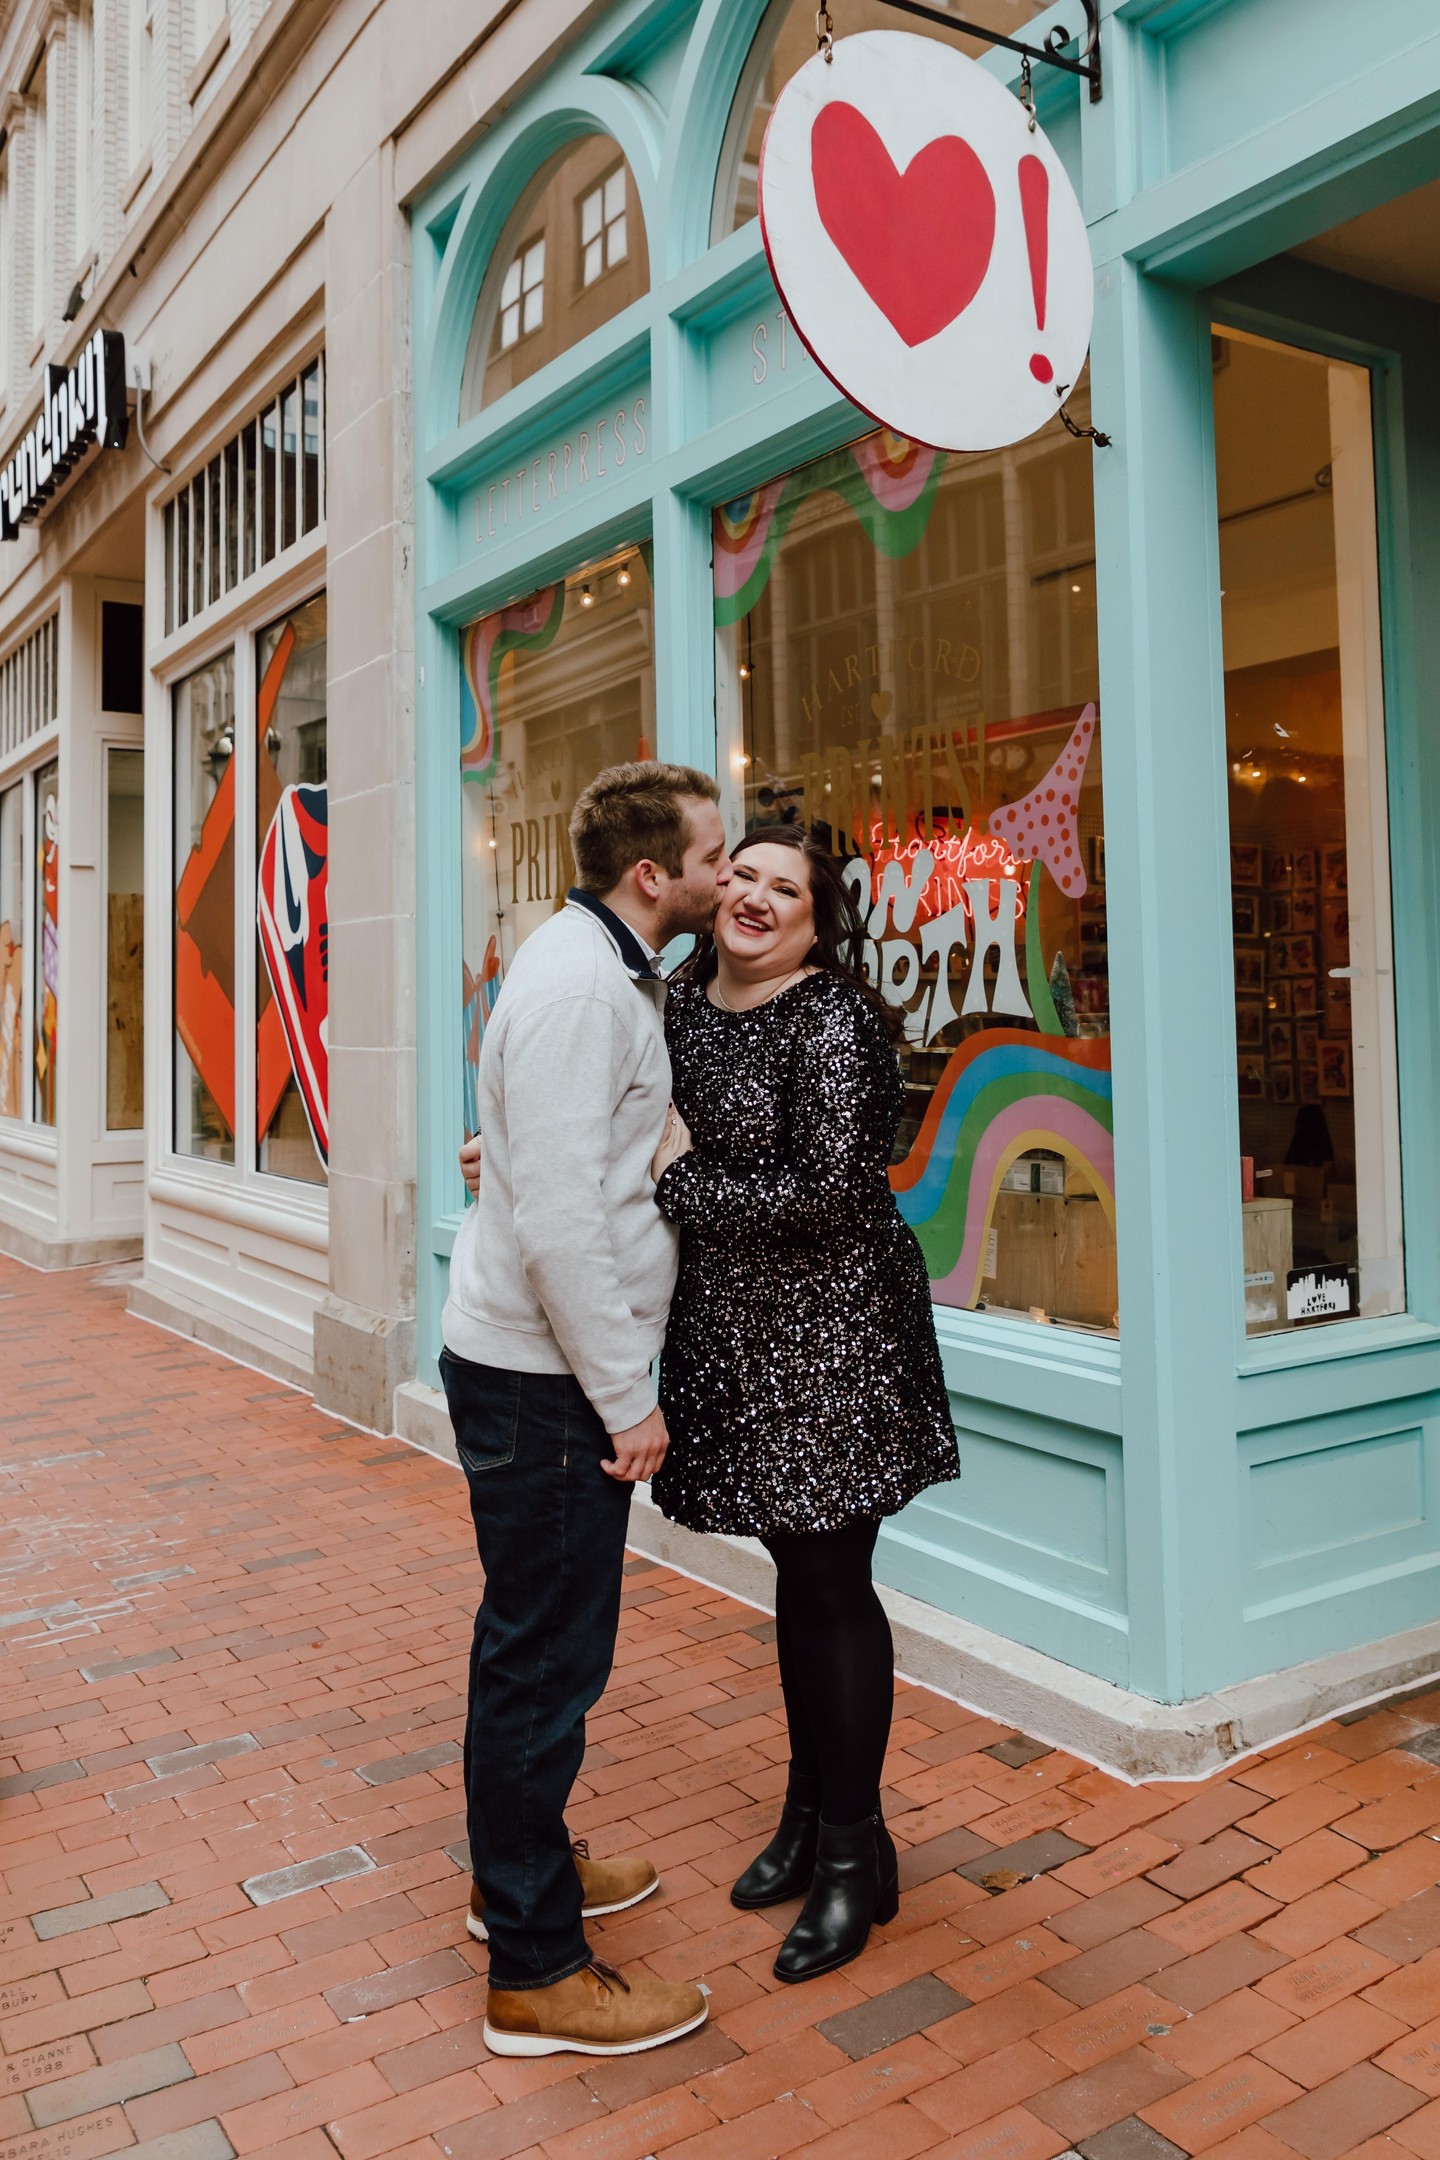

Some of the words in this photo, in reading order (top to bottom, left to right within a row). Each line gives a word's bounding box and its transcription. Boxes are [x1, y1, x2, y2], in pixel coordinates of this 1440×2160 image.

[752, 309, 808, 385] ST
[474, 398, 647, 544] LETTERPRESS
[801, 635, 982, 722] HARTFORD
[1301, 1301, 1336, 1315] HARTFORD
[22, 2044, 74, 2066] DIANNE
[57, 2115, 114, 2142] HUGHES
